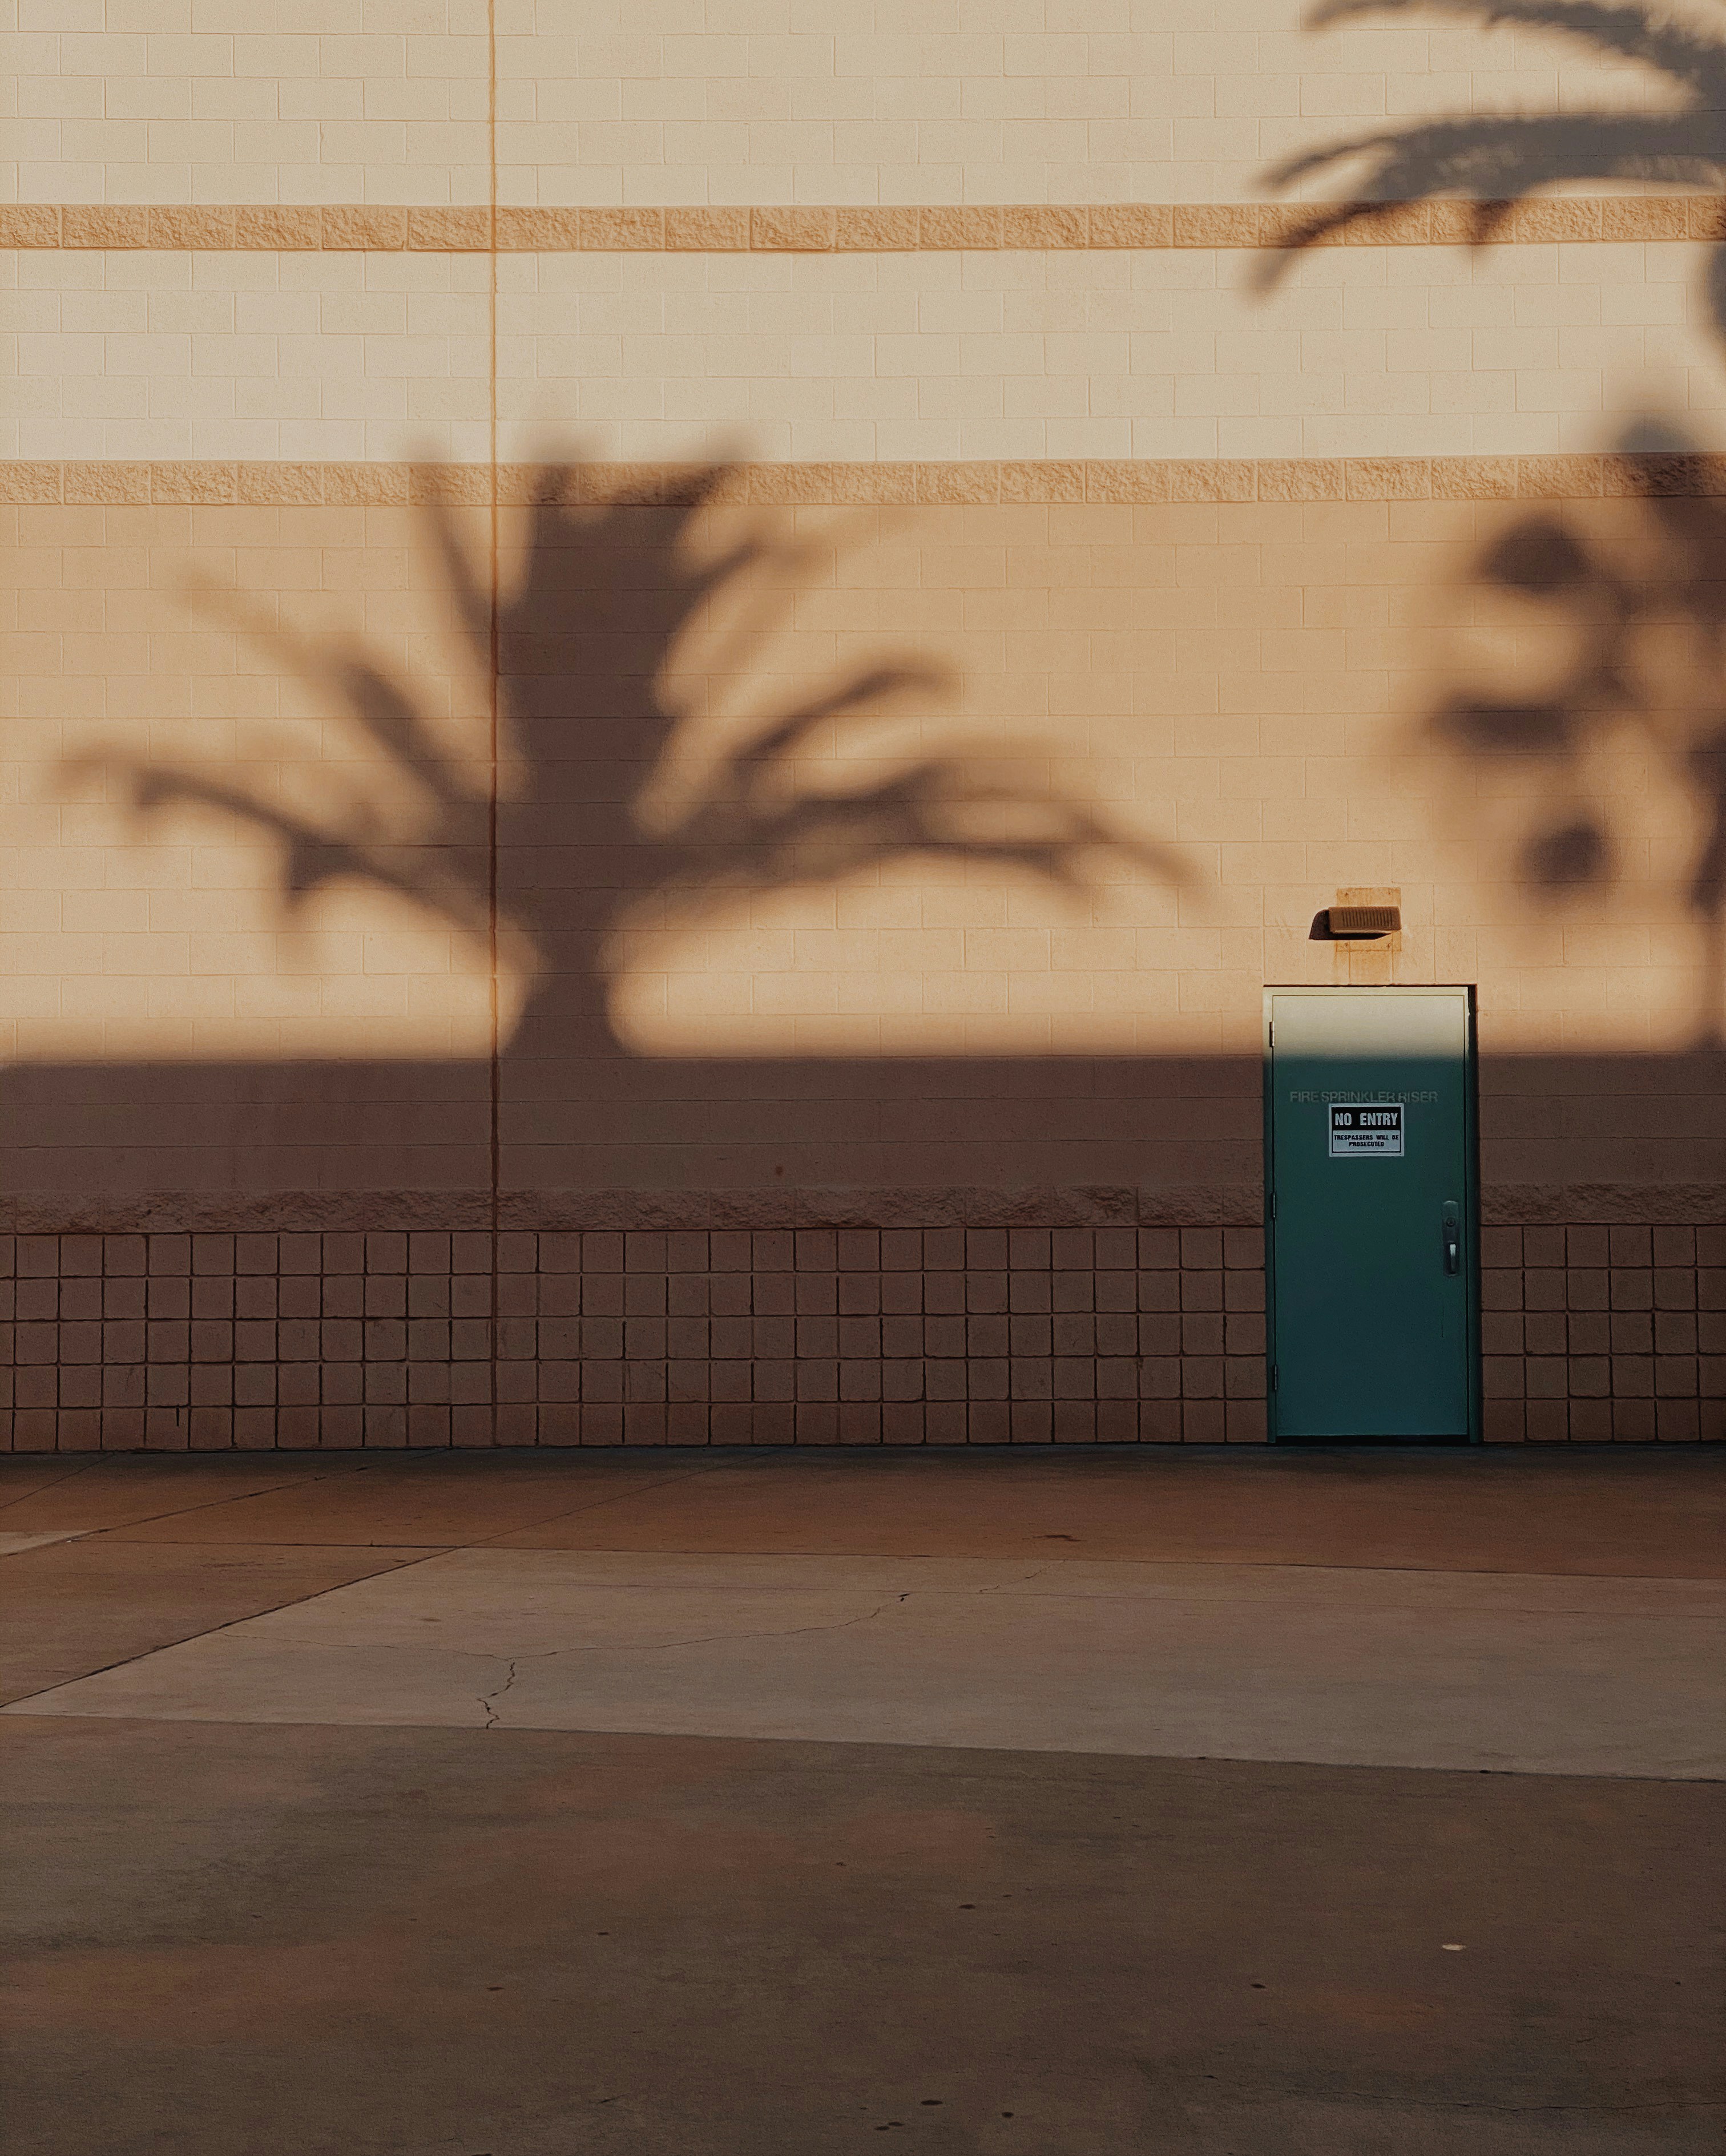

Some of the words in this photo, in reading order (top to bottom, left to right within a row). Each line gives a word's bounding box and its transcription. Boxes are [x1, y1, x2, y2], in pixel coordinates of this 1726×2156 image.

[1290, 1091, 1319, 1103] FIRE
[1321, 1091, 1396, 1103] SPRINKLER
[1398, 1091, 1439, 1103] RISER
[1335, 1113, 1352, 1125] NO
[1360, 1113, 1398, 1125] ENTRY
